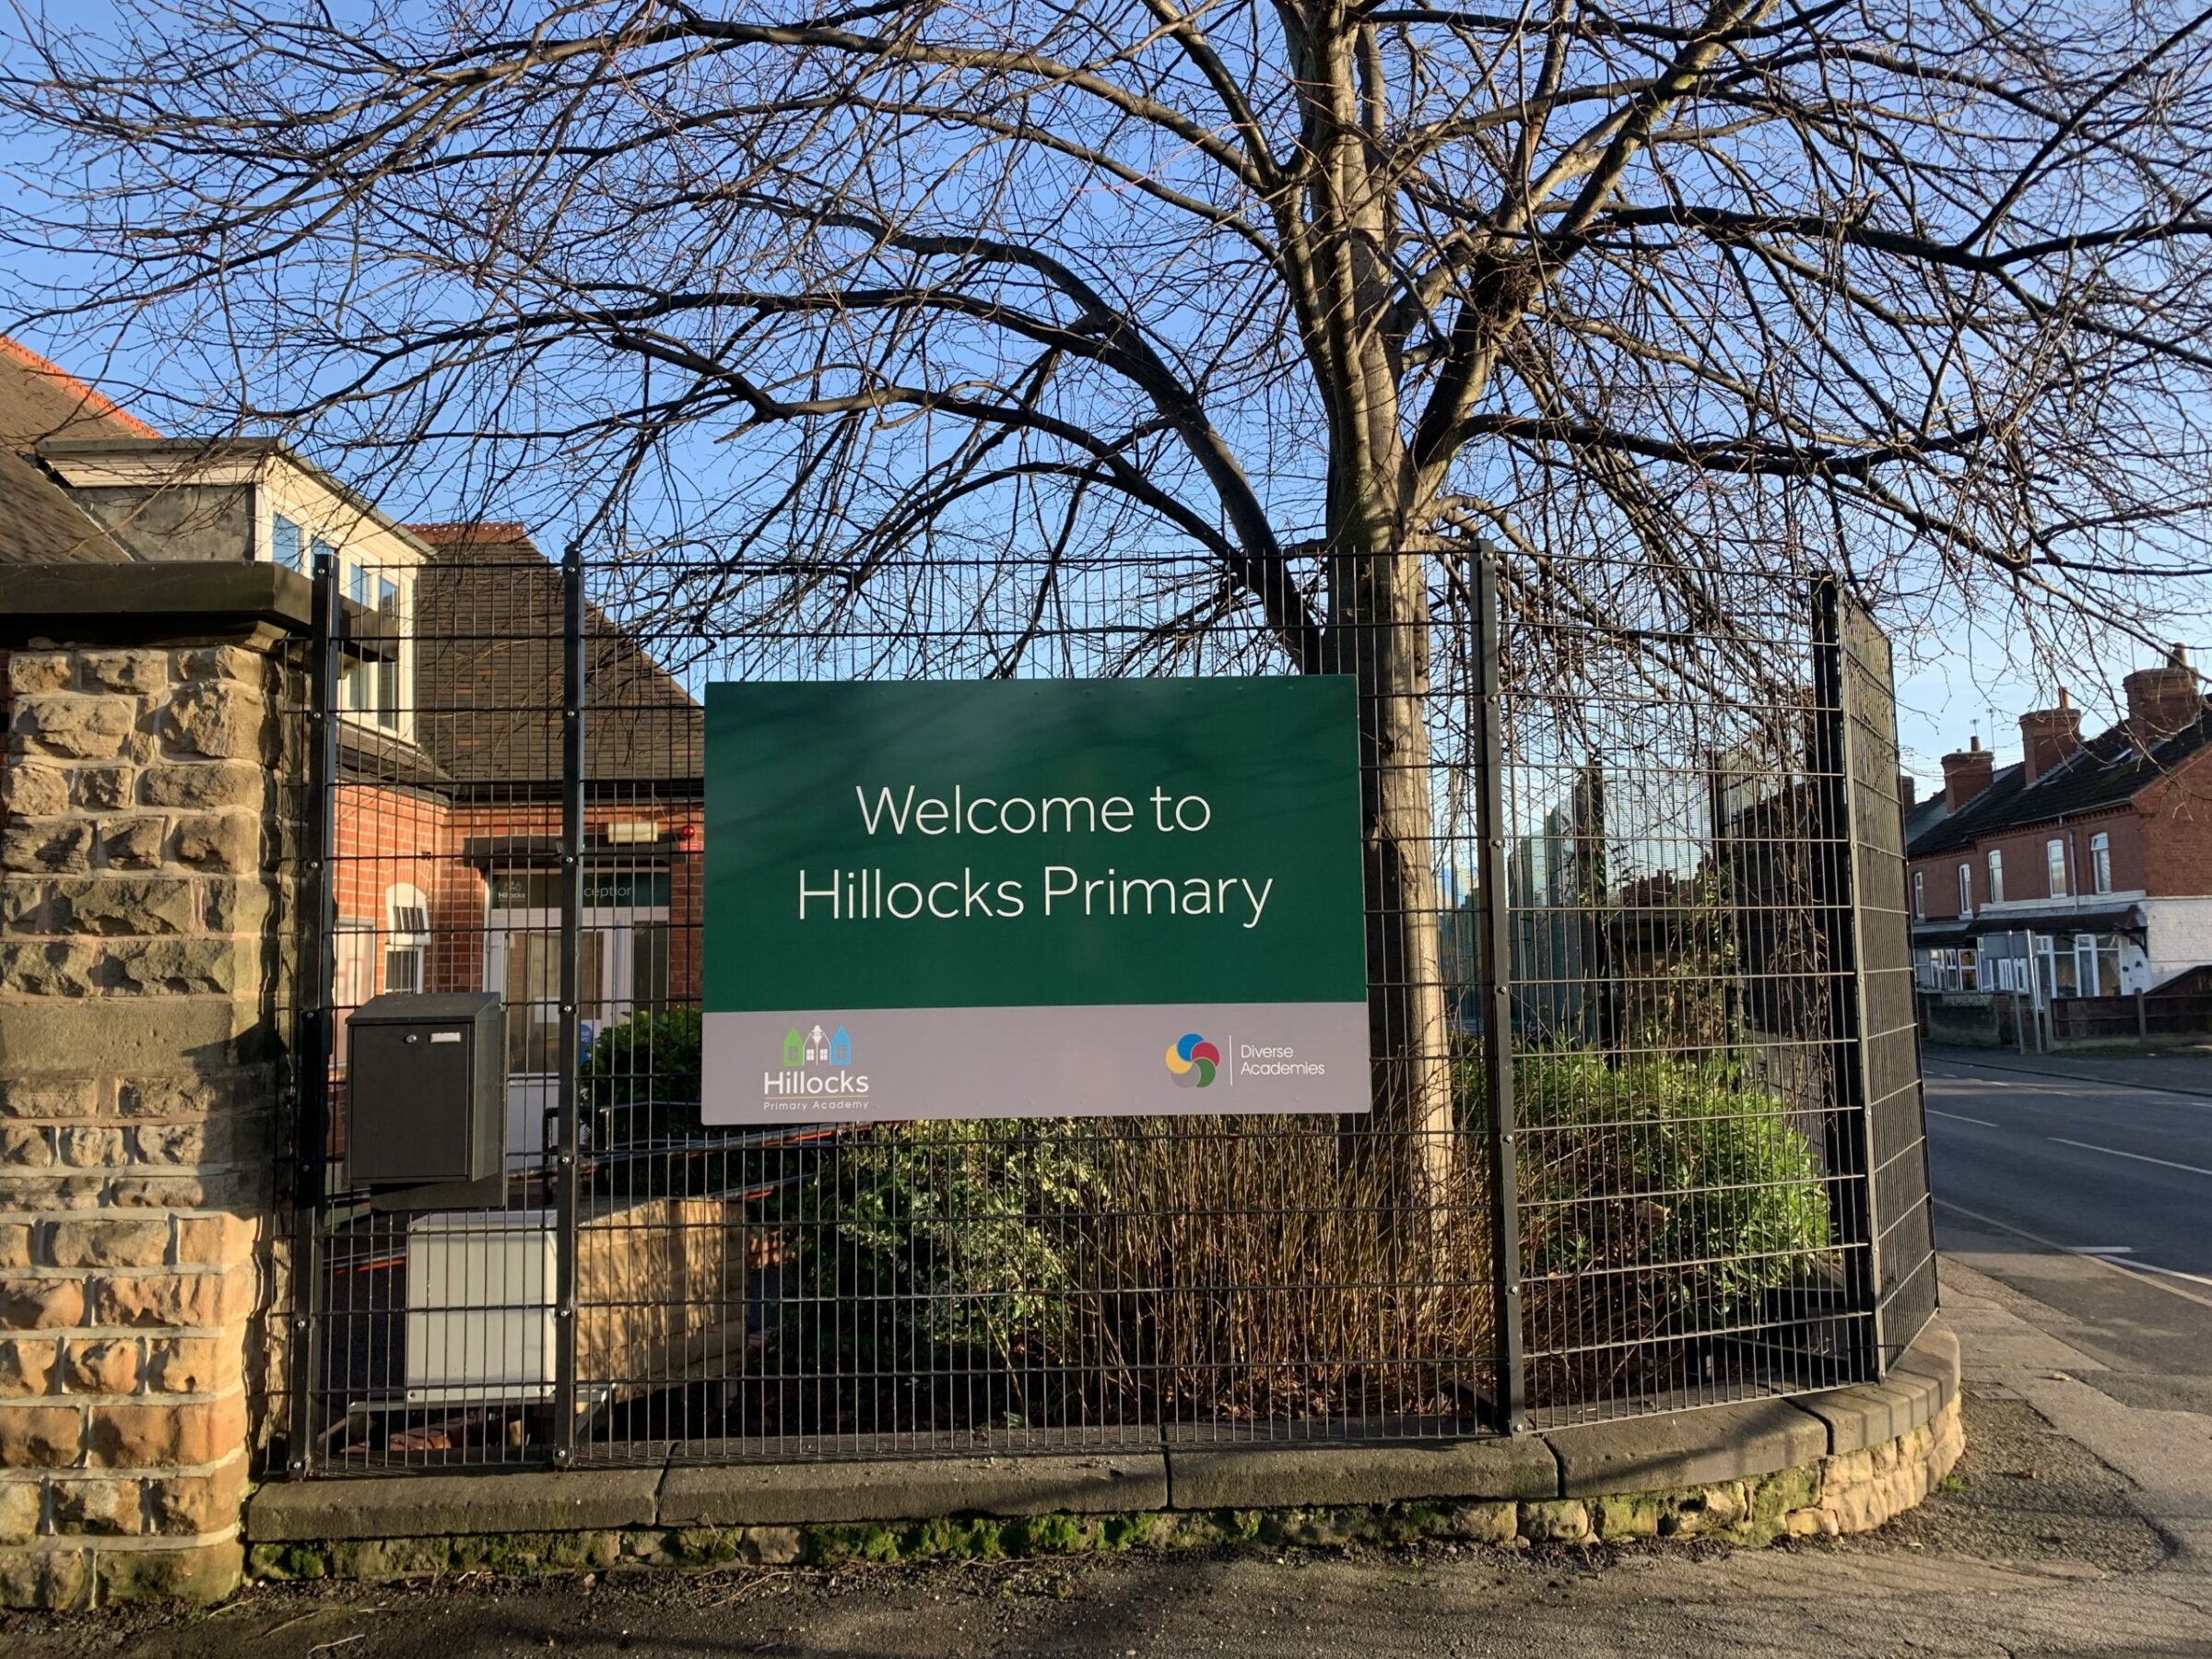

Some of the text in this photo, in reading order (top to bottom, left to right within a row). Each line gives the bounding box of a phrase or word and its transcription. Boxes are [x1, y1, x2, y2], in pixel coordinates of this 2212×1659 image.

[855, 784, 1212, 835] Welcome to
[799, 865, 1274, 929] Hillocks Primary
[1240, 1044, 1294, 1059] Diverse
[1240, 1061, 1325, 1076] Academies
[764, 1069, 869, 1095] Hillocks
[763, 1100, 869, 1111] Primary Academy
